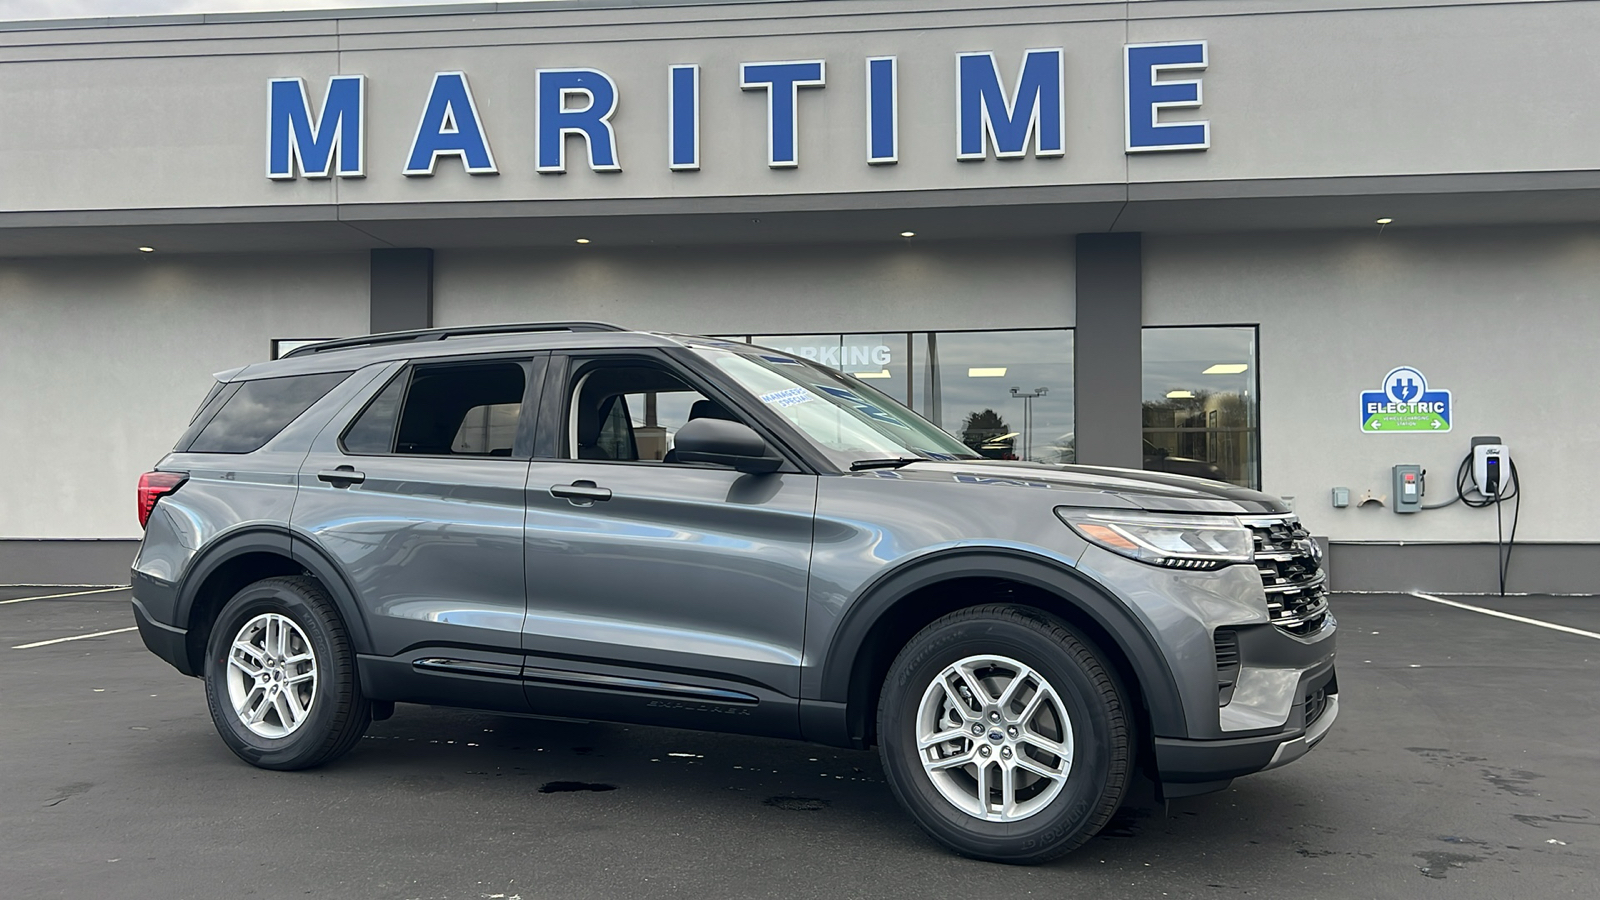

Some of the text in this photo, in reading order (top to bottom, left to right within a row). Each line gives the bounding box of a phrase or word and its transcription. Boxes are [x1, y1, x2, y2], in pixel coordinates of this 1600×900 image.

[266, 39, 1211, 180] MARITIME
[771, 345, 891, 366] RKING
[1367, 402, 1445, 414] ELECTRIC
[646, 700, 751, 716] EXPLORER
